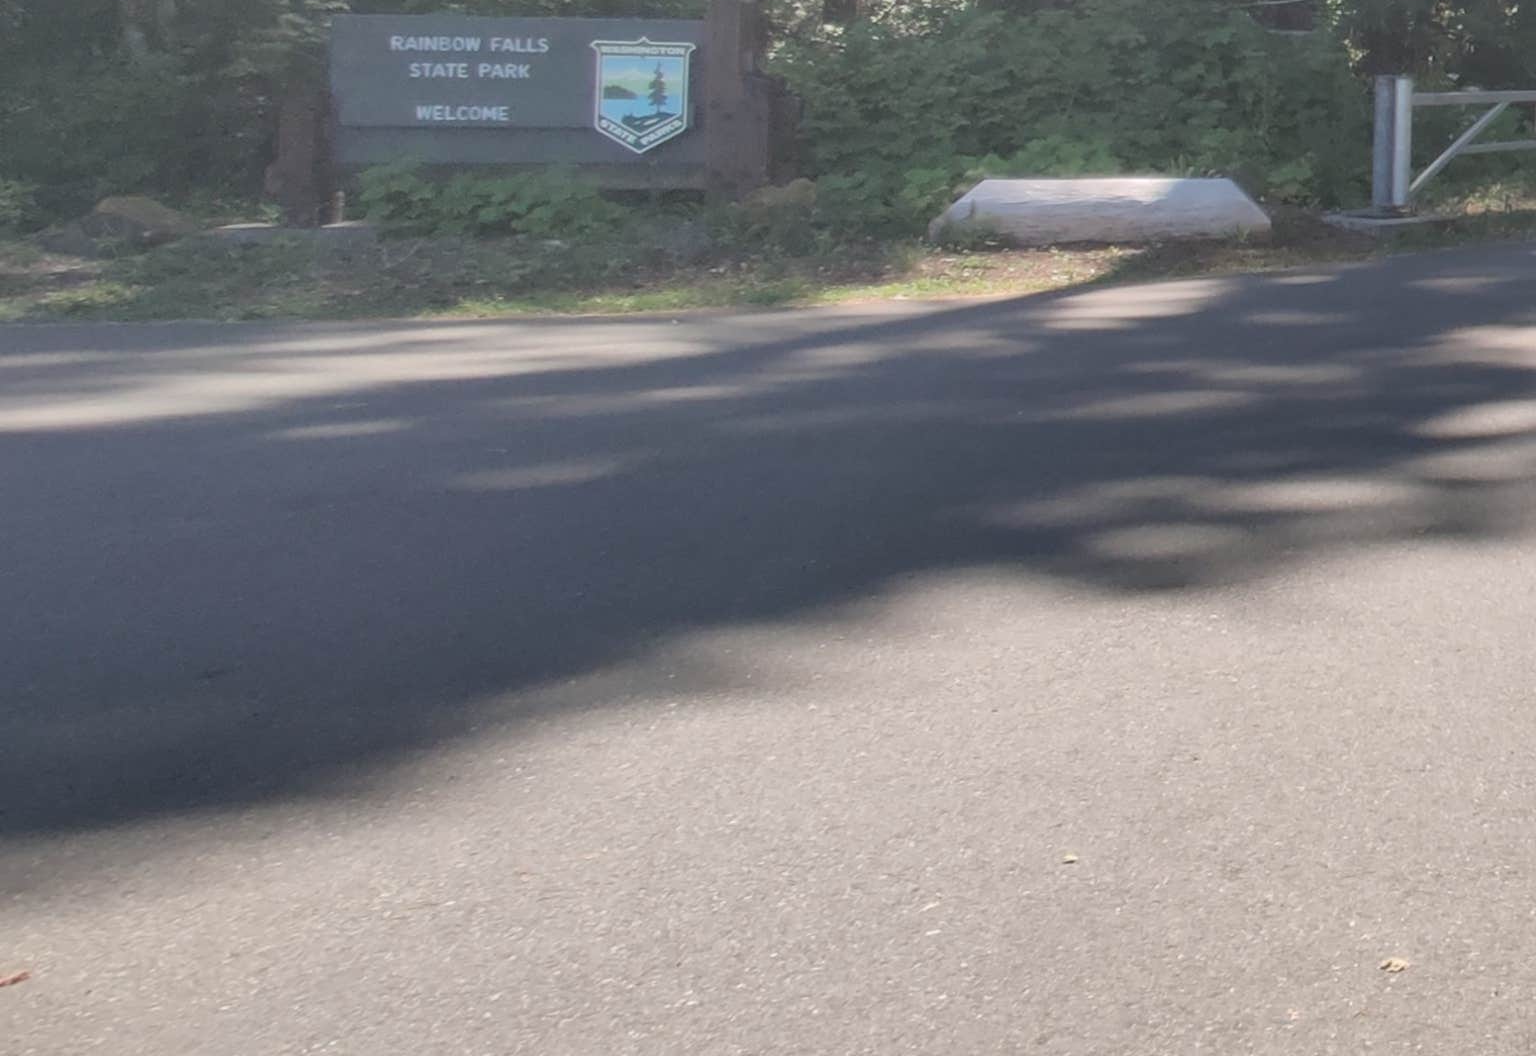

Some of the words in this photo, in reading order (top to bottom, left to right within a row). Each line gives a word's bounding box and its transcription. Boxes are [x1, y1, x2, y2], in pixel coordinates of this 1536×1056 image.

[390, 35, 481, 52] RAINBOW
[490, 37, 549, 53] FALLS
[409, 63, 470, 79] STATE
[478, 63, 531, 79] PARK
[416, 105, 510, 121] WELCOME
